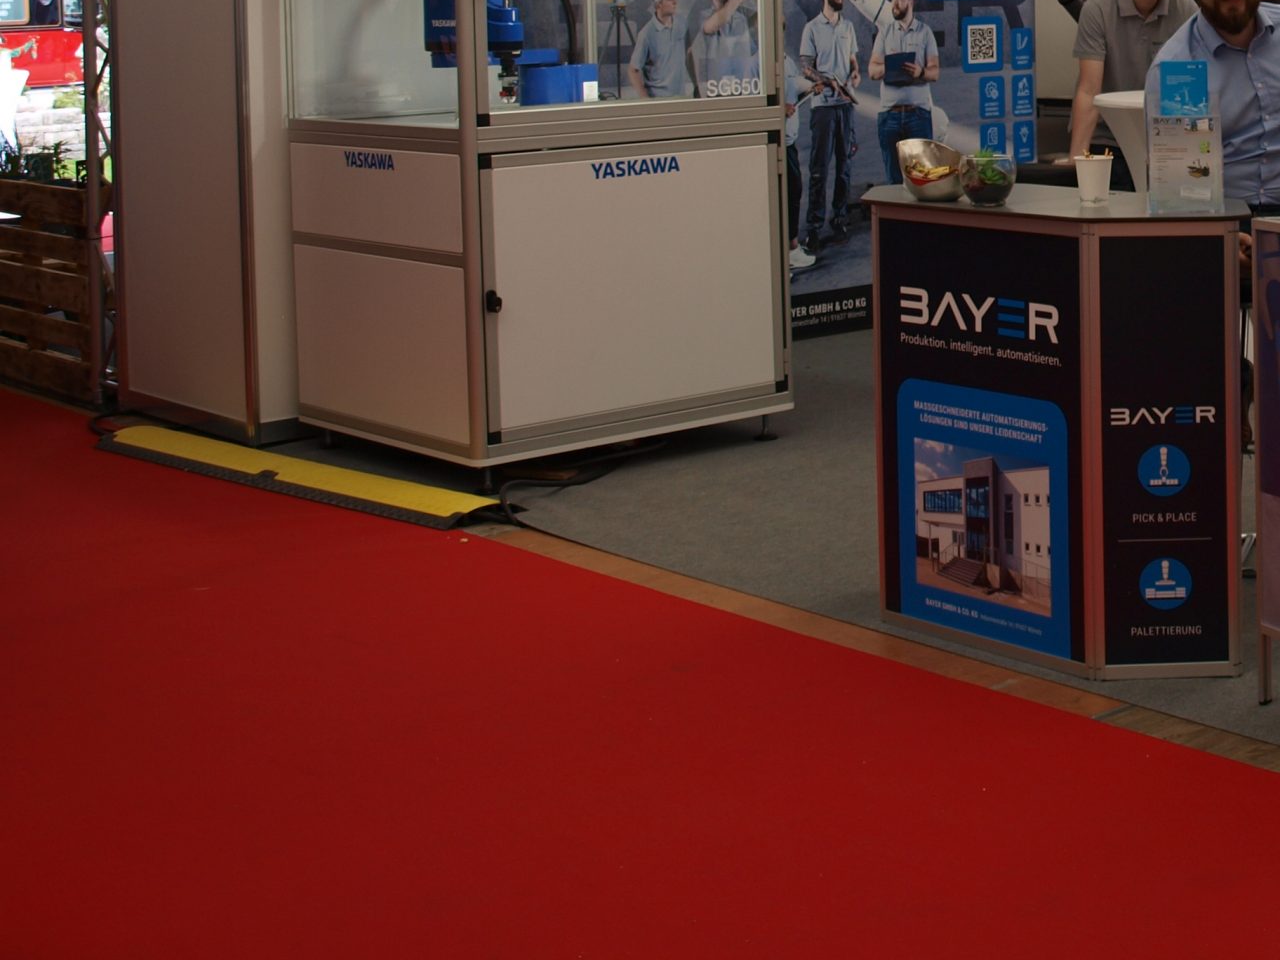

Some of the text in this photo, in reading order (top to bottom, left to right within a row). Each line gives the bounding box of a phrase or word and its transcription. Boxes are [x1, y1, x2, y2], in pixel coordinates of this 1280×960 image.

[431, 18, 457, 29] YASKAW
[705, 78, 760, 97] SG650
[344, 150, 395, 172] YASKAWA
[590, 155, 680, 179] YASKAWA
[791, 307, 807, 318] YER
[808, 302, 833, 315] GMBH
[842, 300, 853, 310] CO
[855, 297, 867, 307] KG
[900, 286, 1059, 344] BAYER
[900, 332, 1062, 367] Produktion. intelligent. automatisieren.
[913, 400, 1049, 433] MASSGESCHNEIDERTE AUTOMATISIERUNGS-
[1110, 405, 1216, 427] BAYER
[919, 412, 1043, 444] LÖSUNGEN SIND UNSERE LEIDENSCHAFT
[1132, 512, 1197, 523] PICK & PLACE
[1130, 625, 1202, 637] PALETTIERUNG
